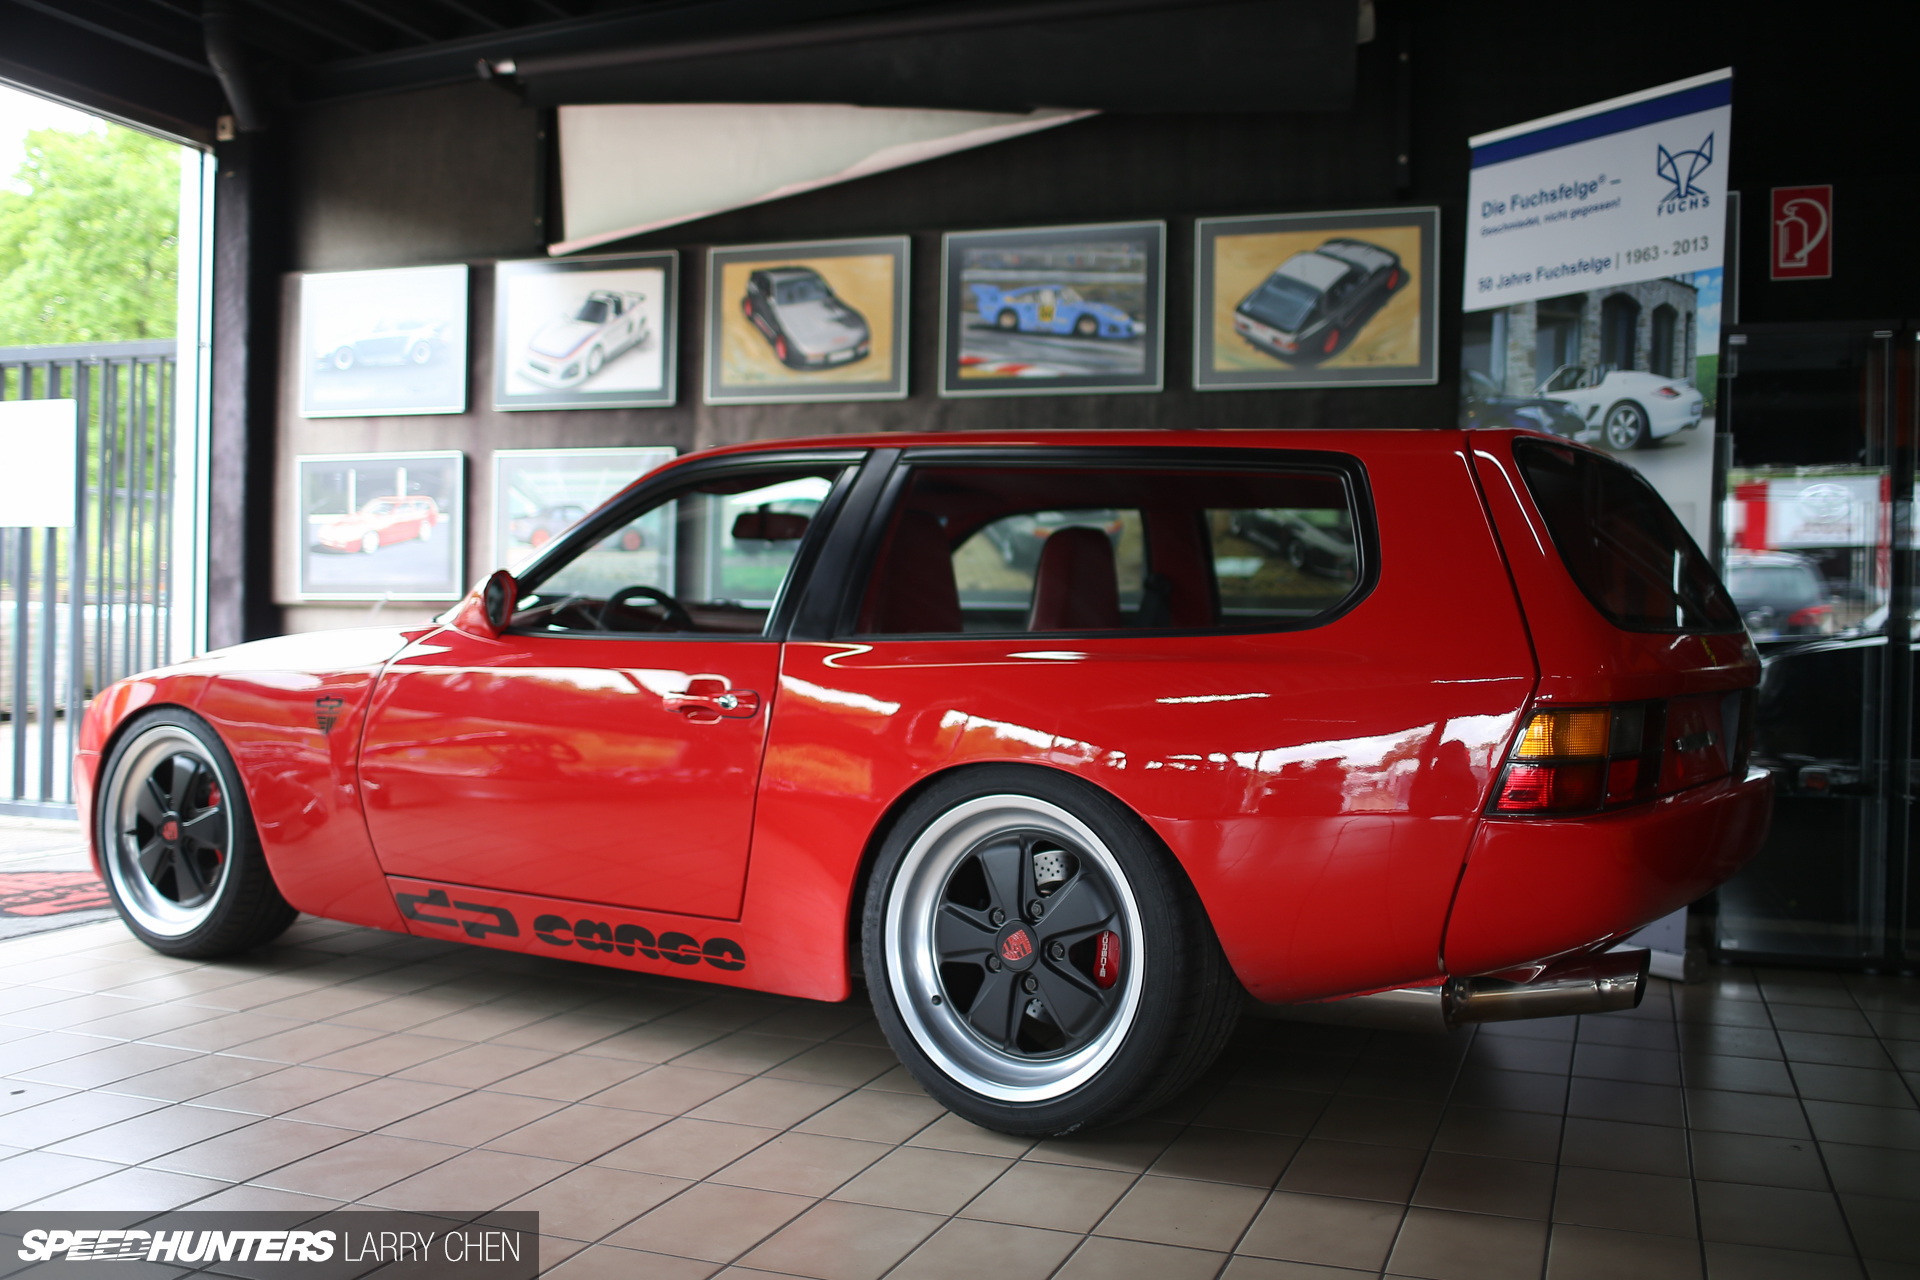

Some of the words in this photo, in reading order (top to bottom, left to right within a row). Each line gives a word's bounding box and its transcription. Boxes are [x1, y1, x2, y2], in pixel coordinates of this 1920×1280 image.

[1481, 200, 1506, 219] Die
[1657, 195, 1710, 217] FUCHS
[1478, 277, 1494, 293] 50
[1496, 271, 1533, 290] Jahre
[1535, 256, 1612, 283] Fuchsfelge
[1624, 245, 1660, 265] 1963
[1672, 235, 1710, 257] 2013
